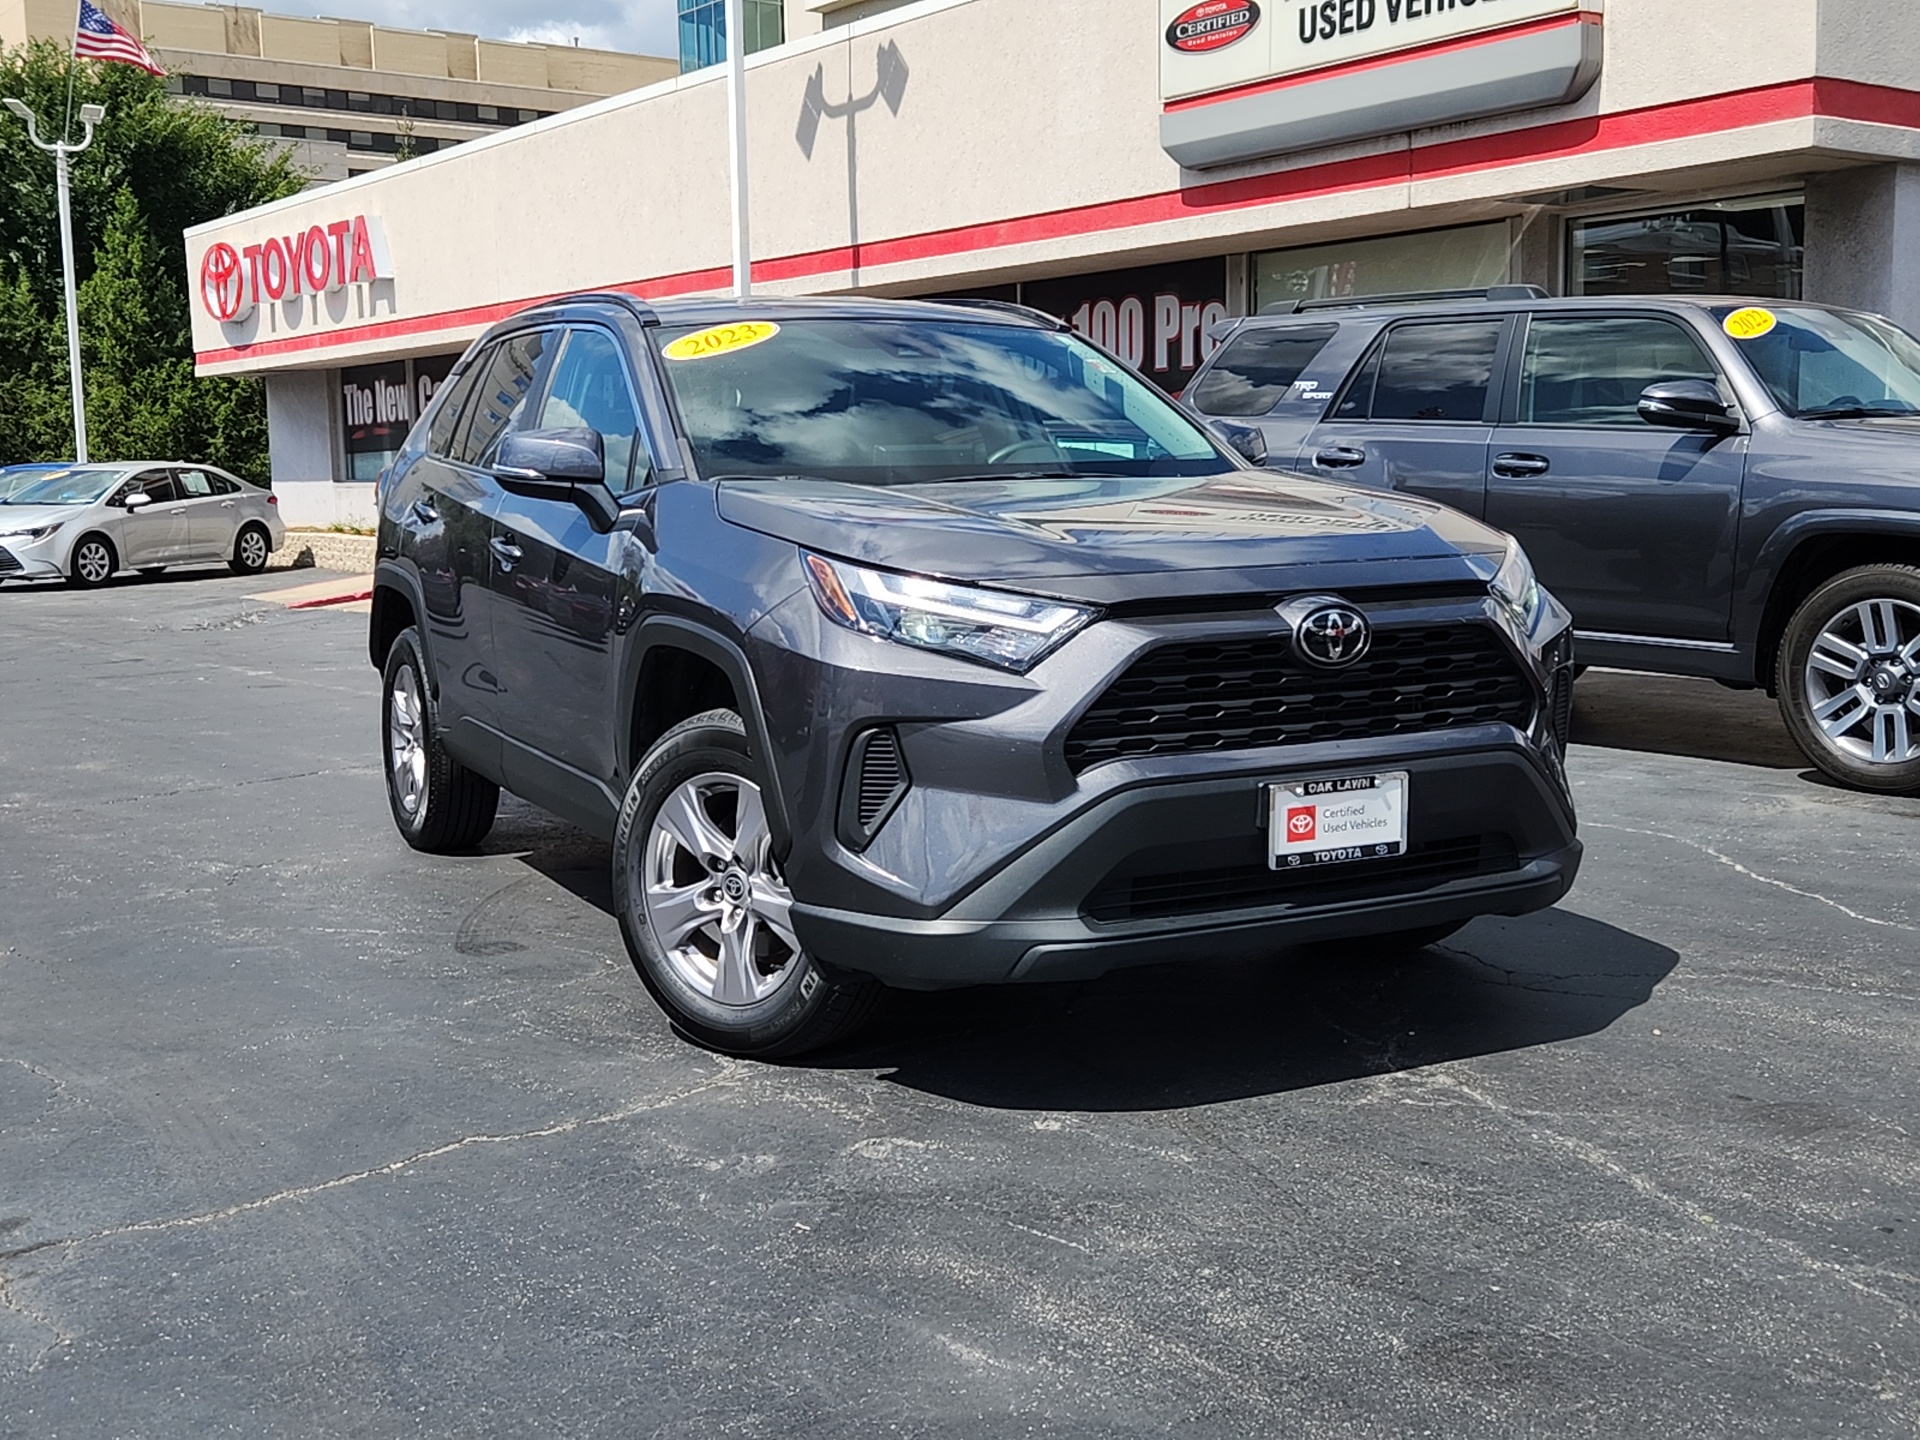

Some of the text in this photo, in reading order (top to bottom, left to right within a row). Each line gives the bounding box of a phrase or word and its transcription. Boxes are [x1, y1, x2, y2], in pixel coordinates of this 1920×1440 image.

[1176, 10, 1250, 38] CERTIFIED
[1299, 0, 1375, 43] USED
[243, 215, 376, 303] TOYOTA
[1733, 310, 1768, 335] 2022
[685, 325, 757, 355] 2023
[343, 384, 374, 426] The
[375, 379, 409, 424] New
[1308, 778, 1370, 793] OAK LAWN
[1323, 805, 1365, 818] Certified
[1323, 817, 1388, 833] Used Vehicles
[1313, 847, 1362, 862] TOYOTA
